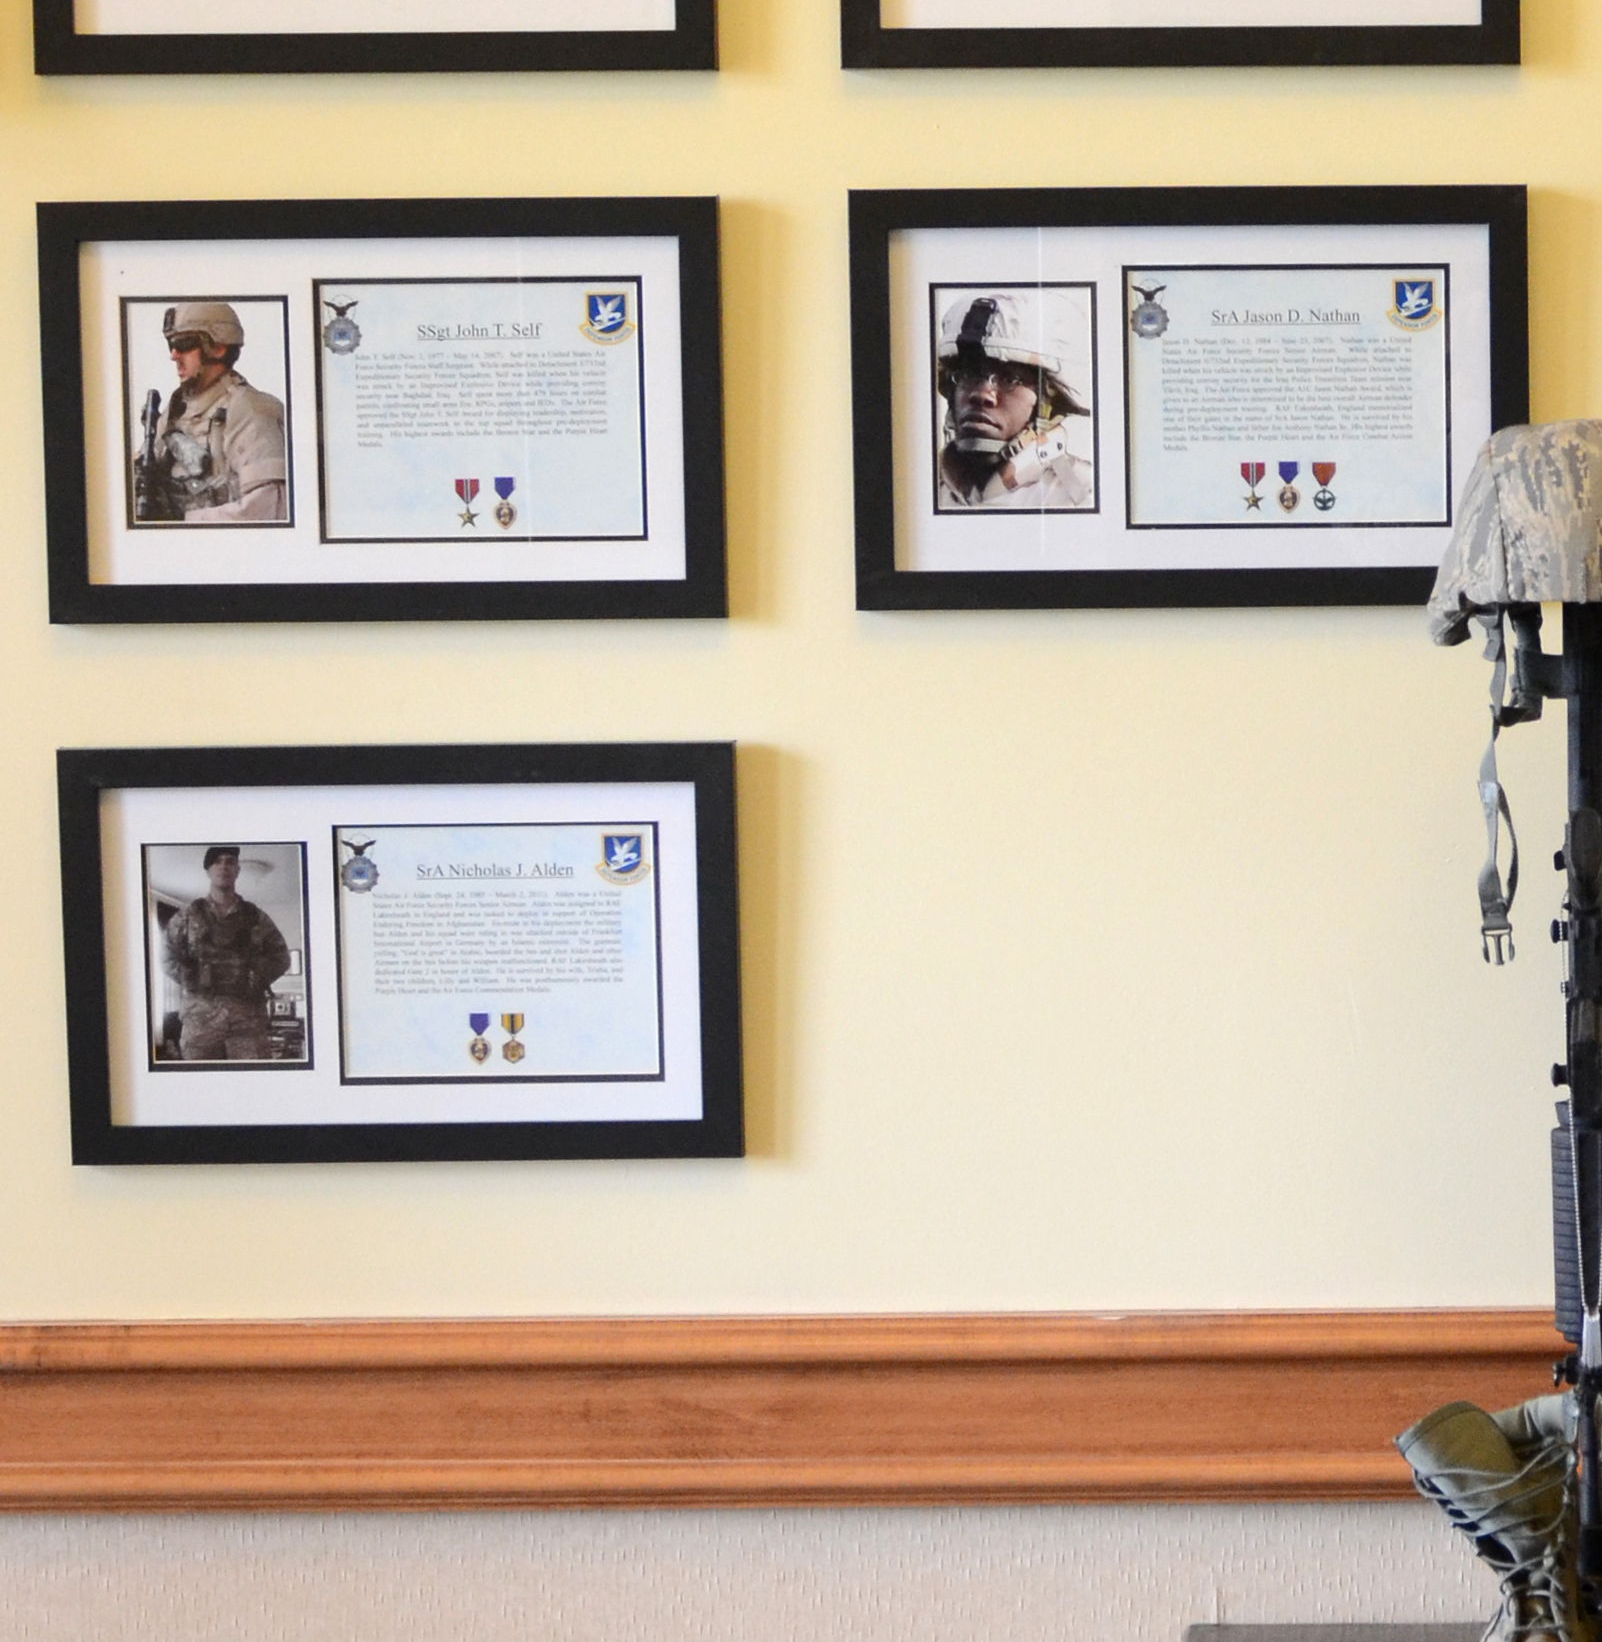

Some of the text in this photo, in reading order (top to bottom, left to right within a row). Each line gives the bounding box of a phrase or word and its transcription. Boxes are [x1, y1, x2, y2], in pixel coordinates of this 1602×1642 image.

[1211, 310, 1239, 323] SrA
[1243, 310, 1283, 323] Jason
[1309, 310, 1360, 323] Nathan
[418, 325, 451, 341] SSgt
[456, 325, 489, 338] John
[512, 323, 542, 337] Self
[417, 864, 445, 877] SrA
[450, 863, 511, 877] Nicholas
[533, 863, 573, 876] Alden
